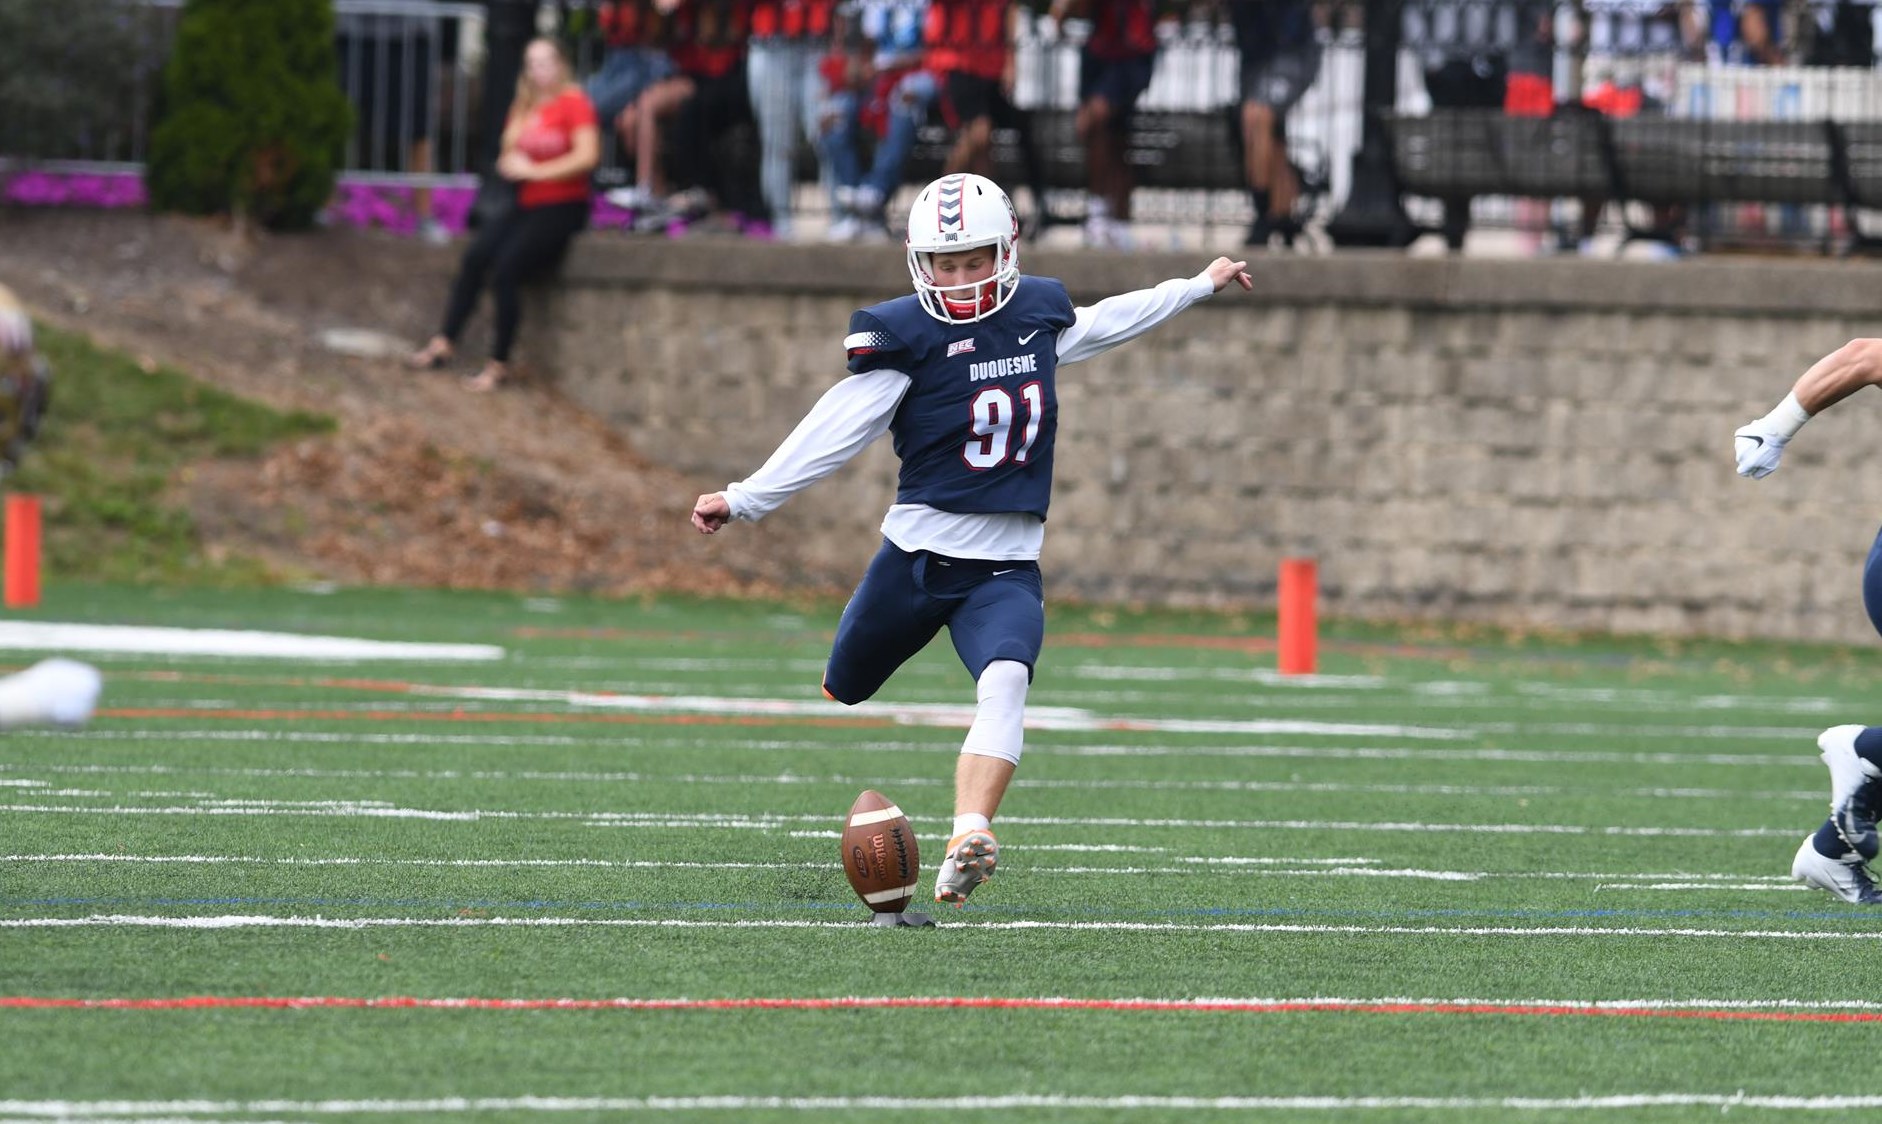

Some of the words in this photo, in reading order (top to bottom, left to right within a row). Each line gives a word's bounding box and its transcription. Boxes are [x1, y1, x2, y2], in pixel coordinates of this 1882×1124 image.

[947, 338, 975, 356] NEC
[969, 353, 1038, 382] DUQUESNE
[961, 380, 1044, 470] 91
[855, 849, 867, 876] GST
[872, 833, 887, 880] Wilson
